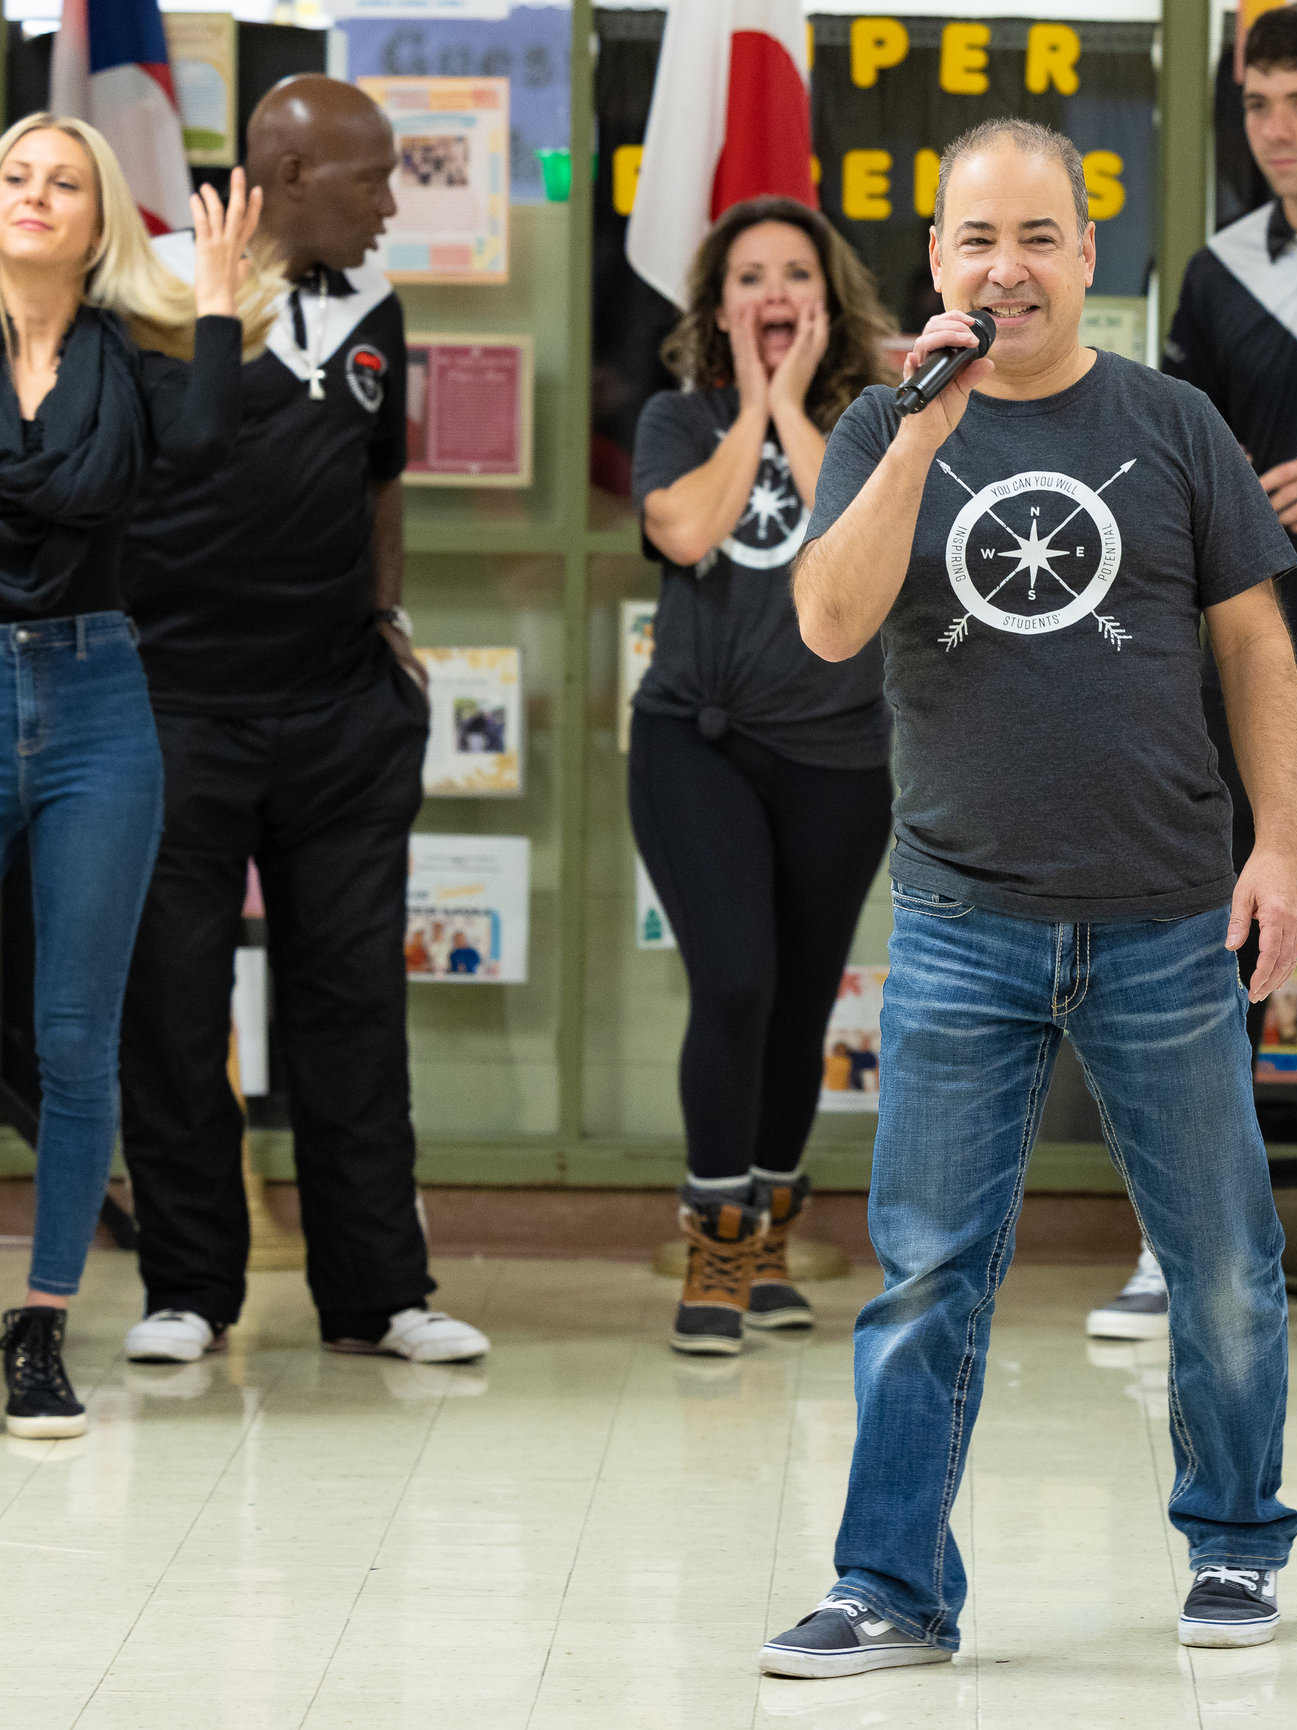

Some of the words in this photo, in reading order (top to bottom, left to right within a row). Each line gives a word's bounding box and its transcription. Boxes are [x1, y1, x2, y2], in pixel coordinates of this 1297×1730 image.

[382, 26, 553, 90] Gues
[806, 16, 1080, 95] PER
[990, 484, 1011, 498] YOU
[1012, 477, 1031, 492] CAN
[1034, 476, 1053, 488] YOU
[1055, 478, 1078, 495] WILL
[1030, 506, 1040, 517] N
[951, 525, 968, 582] INSPIRING
[980, 548, 995, 559] W
[1075, 546, 1085, 557] E
[1097, 523, 1117, 582] POTENTIAL
[1027, 590, 1036, 600] S
[1002, 613, 1061, 629] STUDENTS'
